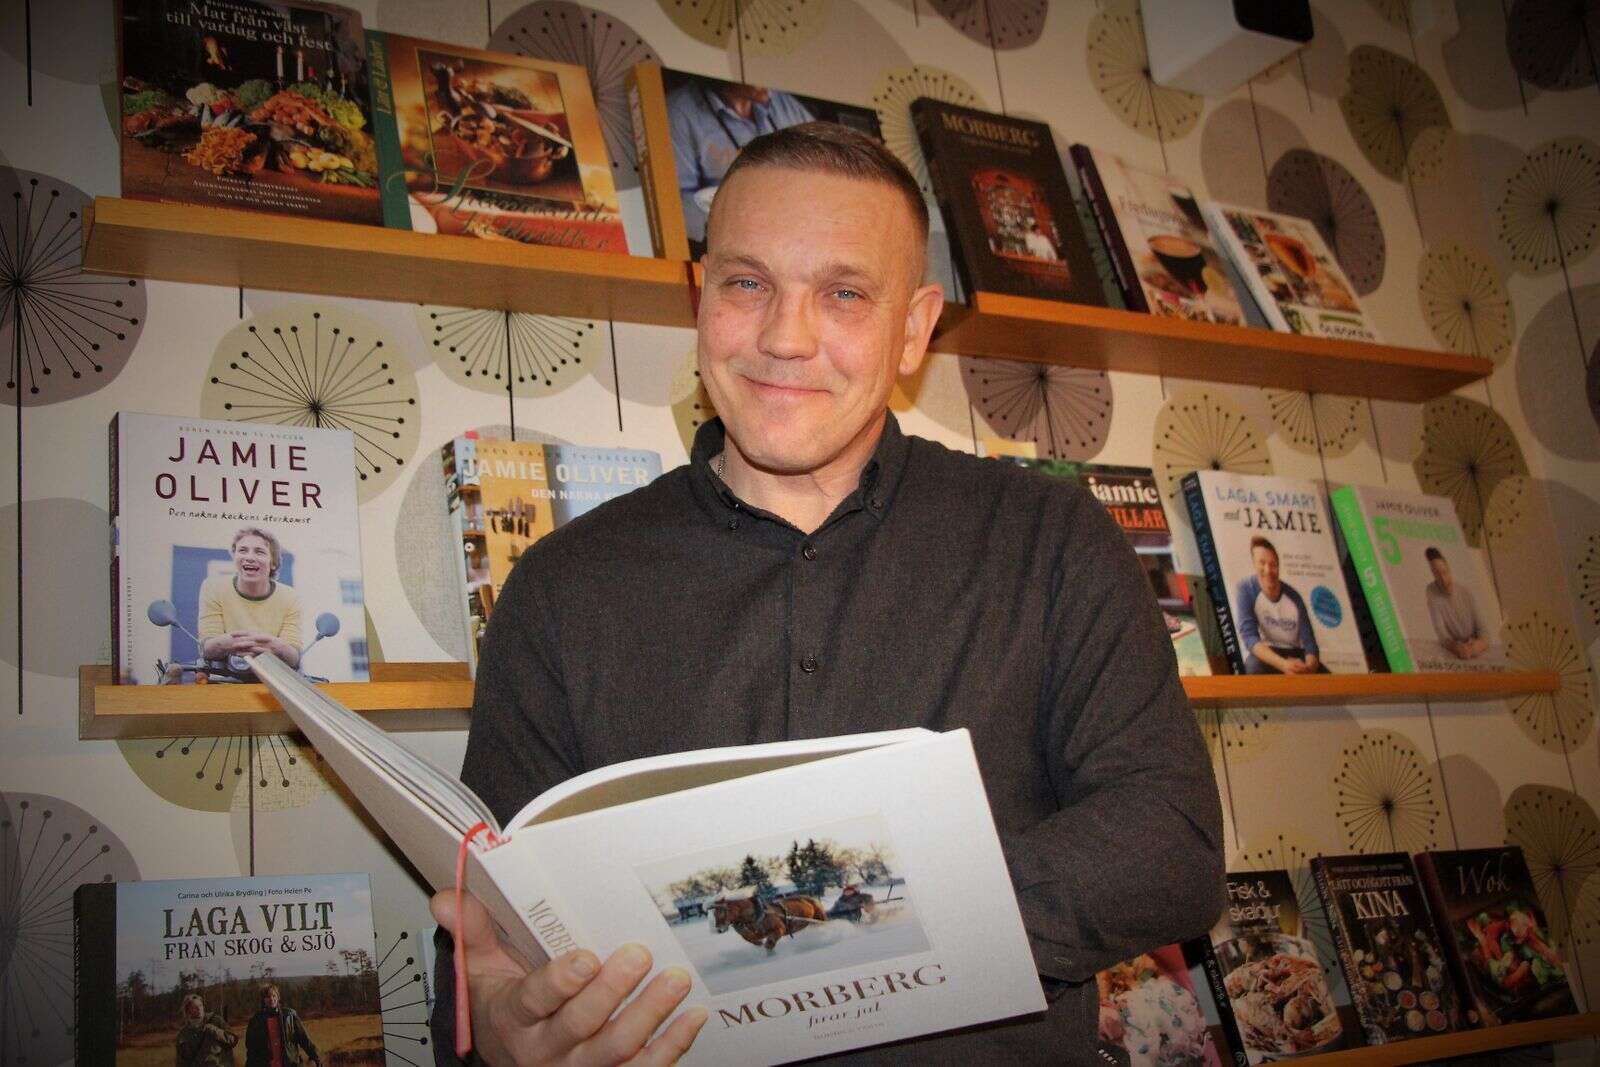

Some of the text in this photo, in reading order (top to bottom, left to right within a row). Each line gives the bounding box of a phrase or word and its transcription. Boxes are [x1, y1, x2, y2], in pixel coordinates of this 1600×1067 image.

[190, 2, 227, 21] Mat
[166, 12, 332, 51] till vardag och fest
[942, 111, 1036, 147] MORBERG
[168, 436, 308, 472] JAMIE
[464, 458, 650, 486] JAMIE OLIVER
[155, 472, 323, 509] OLIVER
[531, 489, 556, 499] DEN
[1215, 487, 1316, 507] LAGA SMART
[168, 507, 311, 524] Den nakna kockens återkomst
[1243, 507, 1322, 534] JAMIE
[1374, 516, 1402, 565] 5
[1226, 880, 1273, 900] Fisk &
[1456, 858, 1512, 896] Wok
[201, 890, 213, 898] och
[214, 889, 235, 898] Ulrika
[236, 889, 264, 898] Brydling
[268, 888, 283, 896] Foto
[1349, 889, 1410, 920] KINA
[163, 902, 334, 938] LAGA VILT
[528, 897, 578, 956] MORBE
[165, 931, 335, 961] FRÅN SKOG & SJÖ
[717, 963, 948, 1029] MORBERG
[806, 1001, 881, 1029] firar jul
